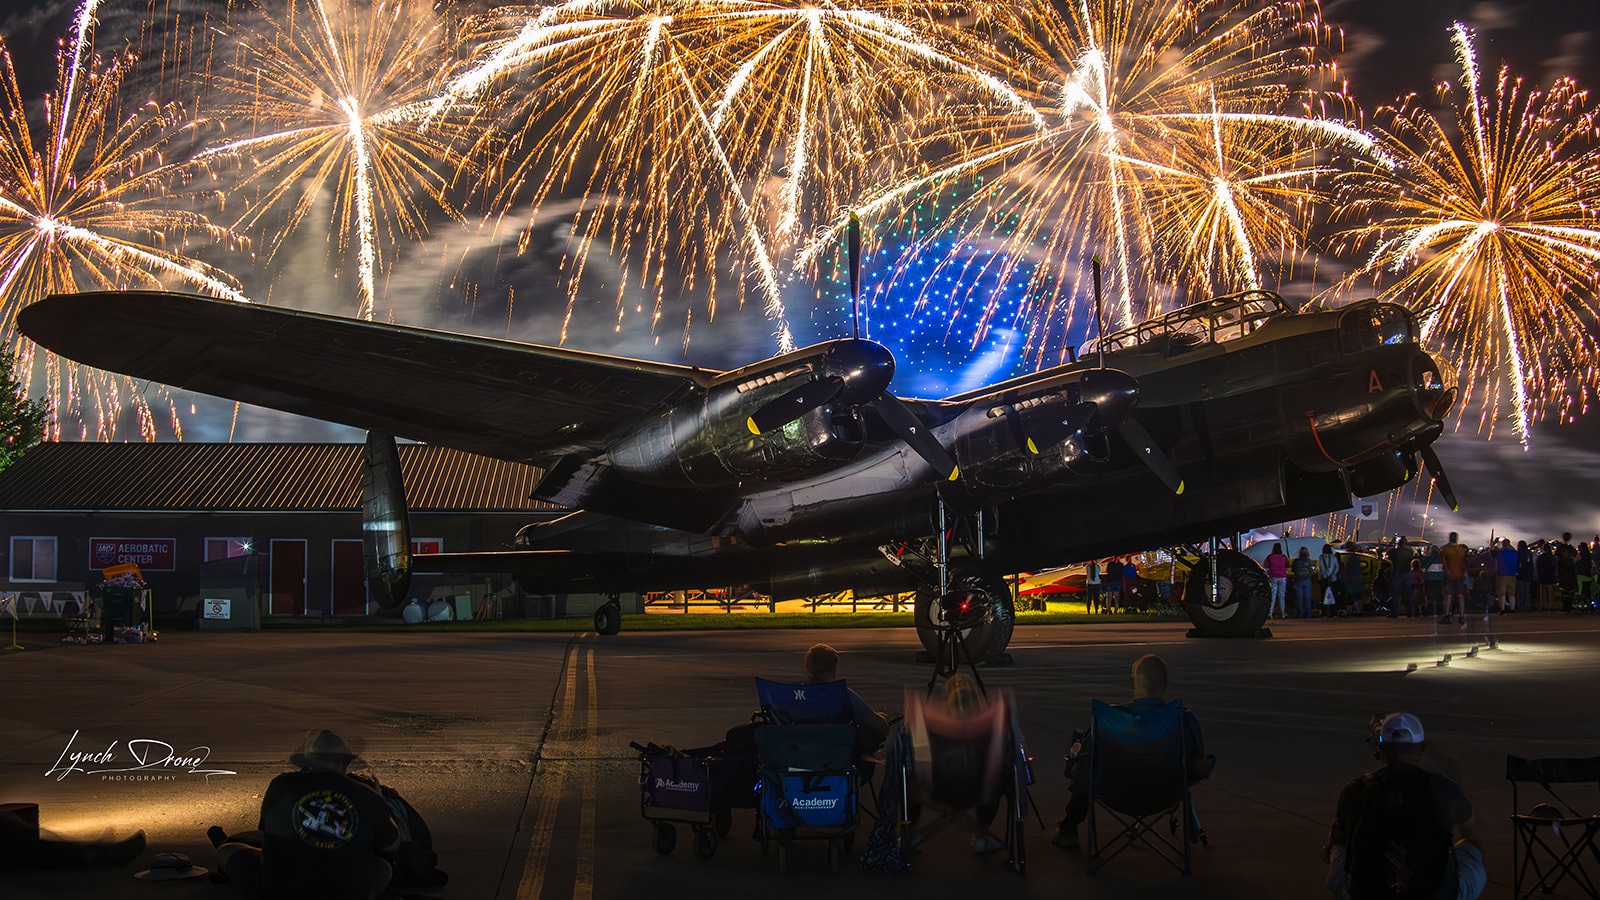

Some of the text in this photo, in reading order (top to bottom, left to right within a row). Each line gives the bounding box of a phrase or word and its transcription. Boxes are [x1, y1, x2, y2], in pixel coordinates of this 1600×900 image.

[1369, 369, 1383, 393] A
[118, 543, 168, 553] AEROBATIC
[118, 554, 153, 564] CENTER
[665, 779, 700, 791] Academy
[792, 797, 838, 808] Academy
